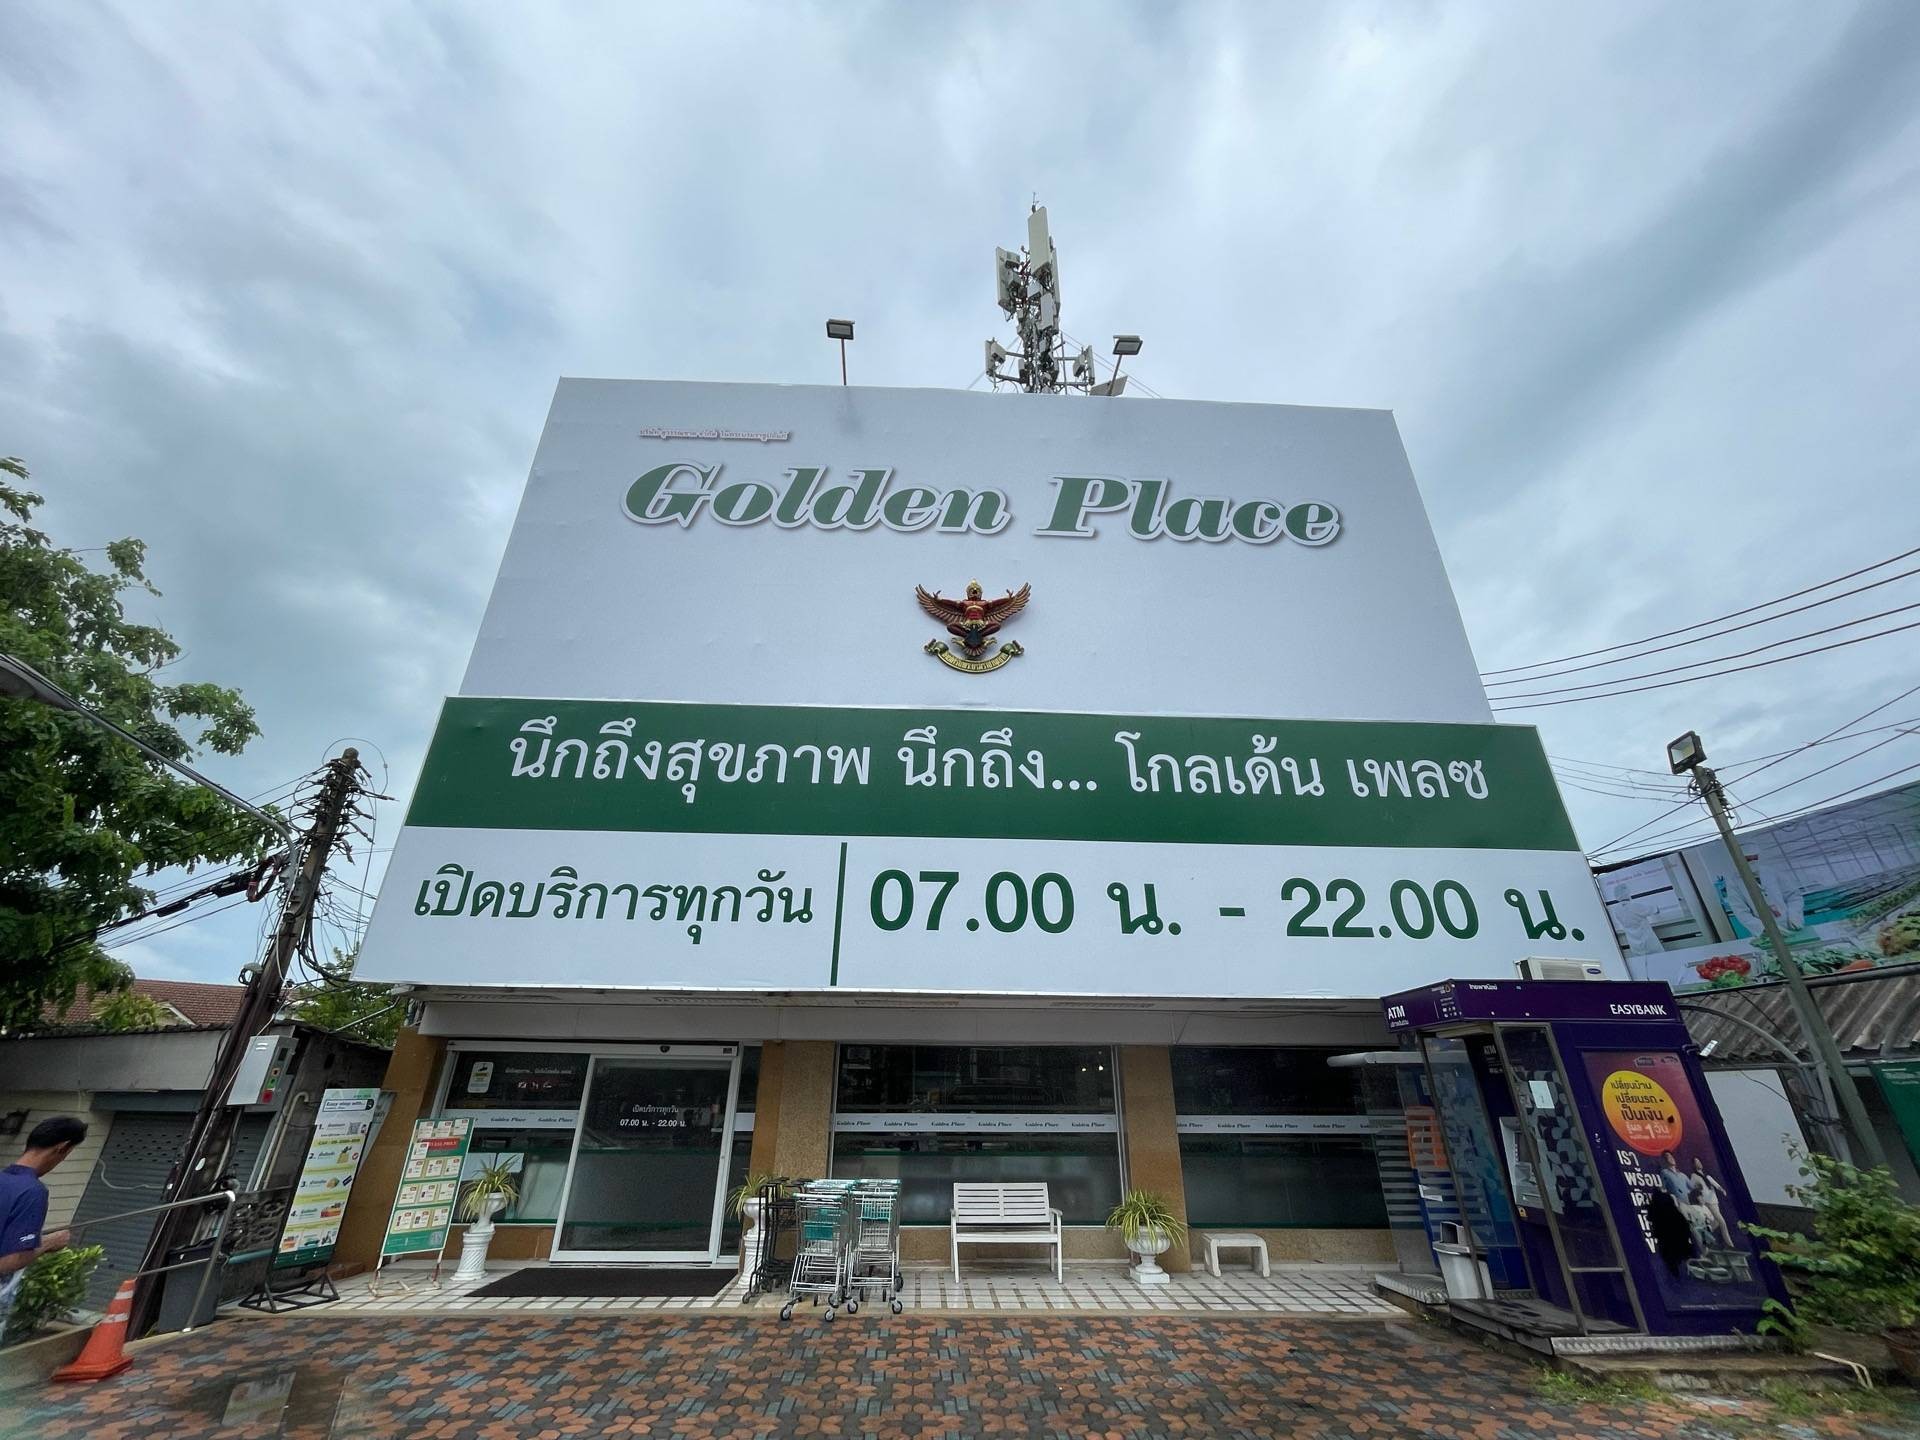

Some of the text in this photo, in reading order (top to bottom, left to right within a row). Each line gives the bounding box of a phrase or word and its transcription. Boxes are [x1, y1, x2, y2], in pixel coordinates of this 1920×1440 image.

[627, 462, 1341, 545] Golden Place
[509, 715, 1489, 804] นึกถึงสุขภาพ นึกถึง... โกลเด้น เพลซ
[415, 863, 813, 945] เปิดบริการทุกวัน
[870, 869, 1075, 934] 07.00
[1106, 881, 1182, 936] น.
[1280, 878, 1479, 940] 22.00
[1503, 888, 1585, 942] น.
[1387, 1005, 1406, 1020] ATM
[1610, 1004, 1667, 1015] EASYBANK
[1611, 1077, 1653, 1090] เปลี่ยนบ้าน
[1616, 1092, 1658, 1104] เปลี่ยนรถ
[1620, 1104, 1664, 1121] เป็นเงิน
[620, 1118, 640, 1127] 07.00
[657, 1119, 678, 1127] 22.00
[1616, 1149, 1640, 1167] เรา
[1623, 1167, 1663, 1188] พร้อม
